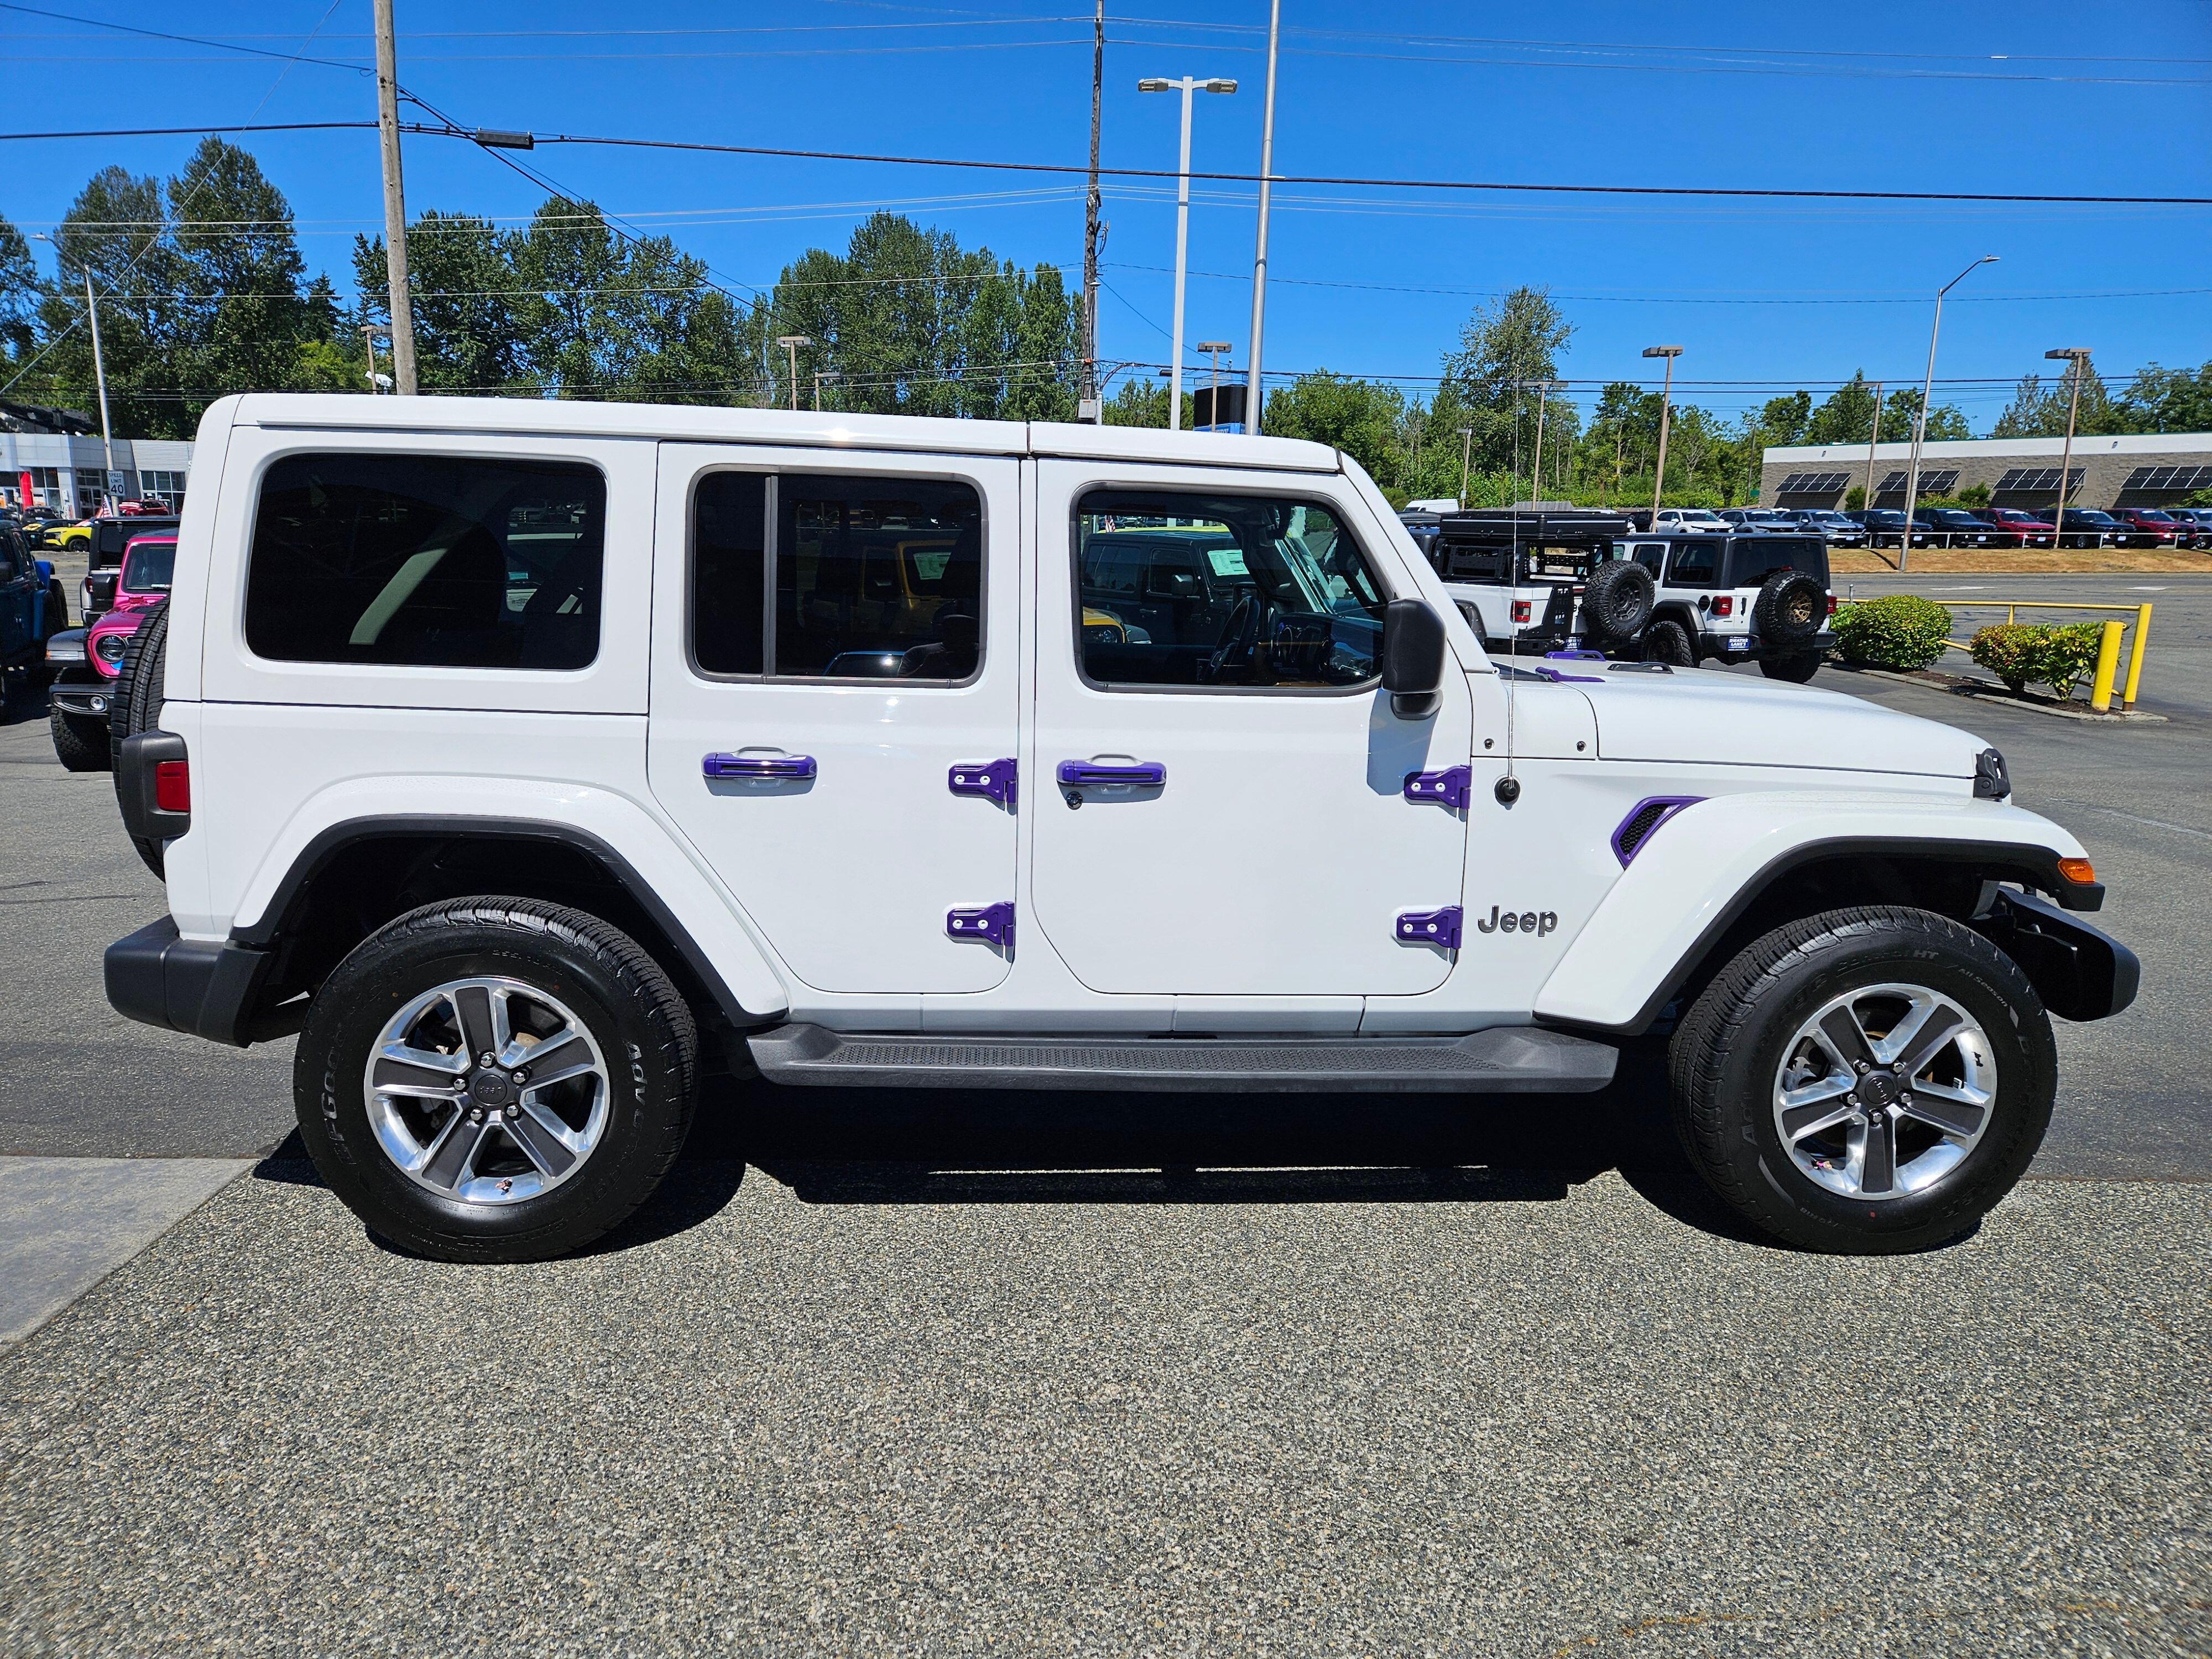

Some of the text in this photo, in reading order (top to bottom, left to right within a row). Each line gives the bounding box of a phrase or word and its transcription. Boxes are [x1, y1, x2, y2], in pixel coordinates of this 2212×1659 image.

[111, 484, 124, 494] 40
[1478, 905, 1558, 937] Jeep
[1913, 949, 1939, 959] HT
[1958, 968, 2008, 1007] All Season
